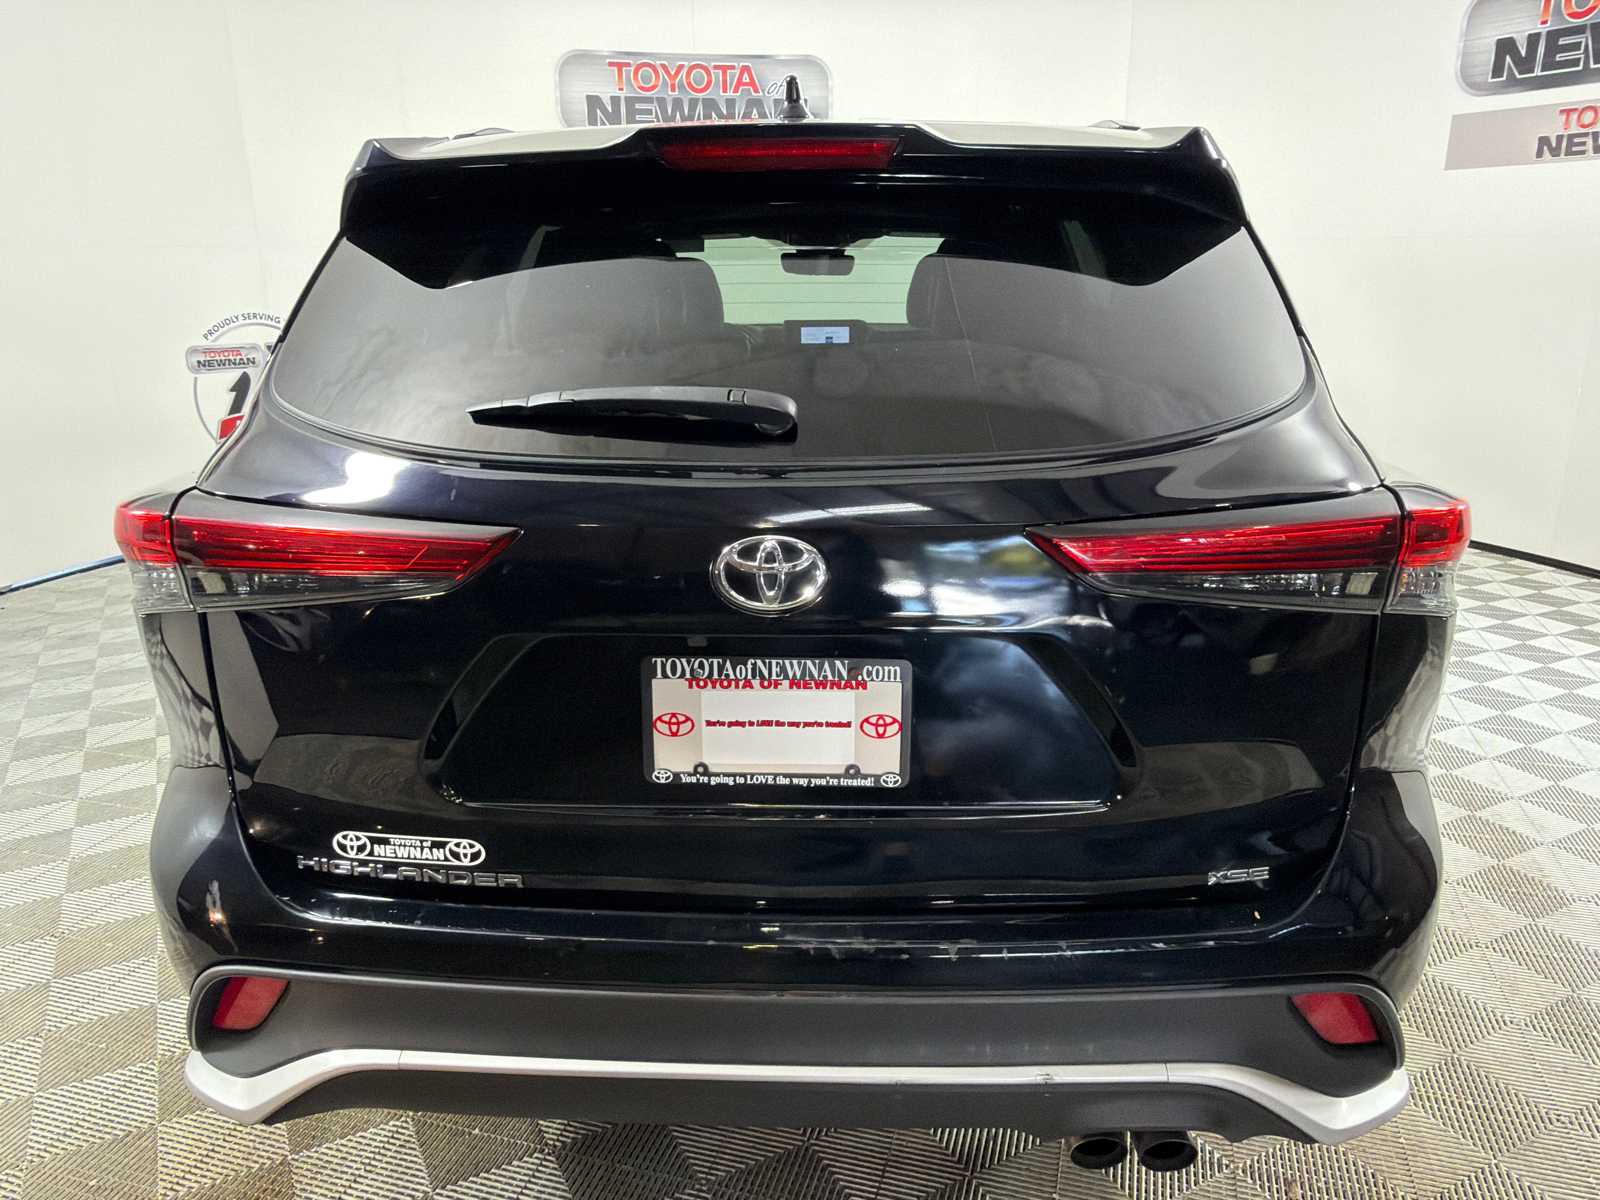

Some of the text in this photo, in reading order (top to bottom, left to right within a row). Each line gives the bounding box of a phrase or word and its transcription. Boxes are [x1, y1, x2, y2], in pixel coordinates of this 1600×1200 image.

[607, 61, 789, 95] TOYOTA of
[202, 312, 281, 341] PROUDLY SERVING
[202, 349, 242, 359] TOYOTA
[197, 357, 256, 369] NEWNAN
[685, 678, 868, 691] TOYOTA OF NEWNAN
[680, 774, 875, 787] You're going to LOVE the way you're treated!
[389, 838, 432, 848] TOYOTA of
[373, 844, 445, 861] NEWNAN
[297, 855, 524, 888] HIGHLANDER
[1208, 866, 1270, 886] XSE
